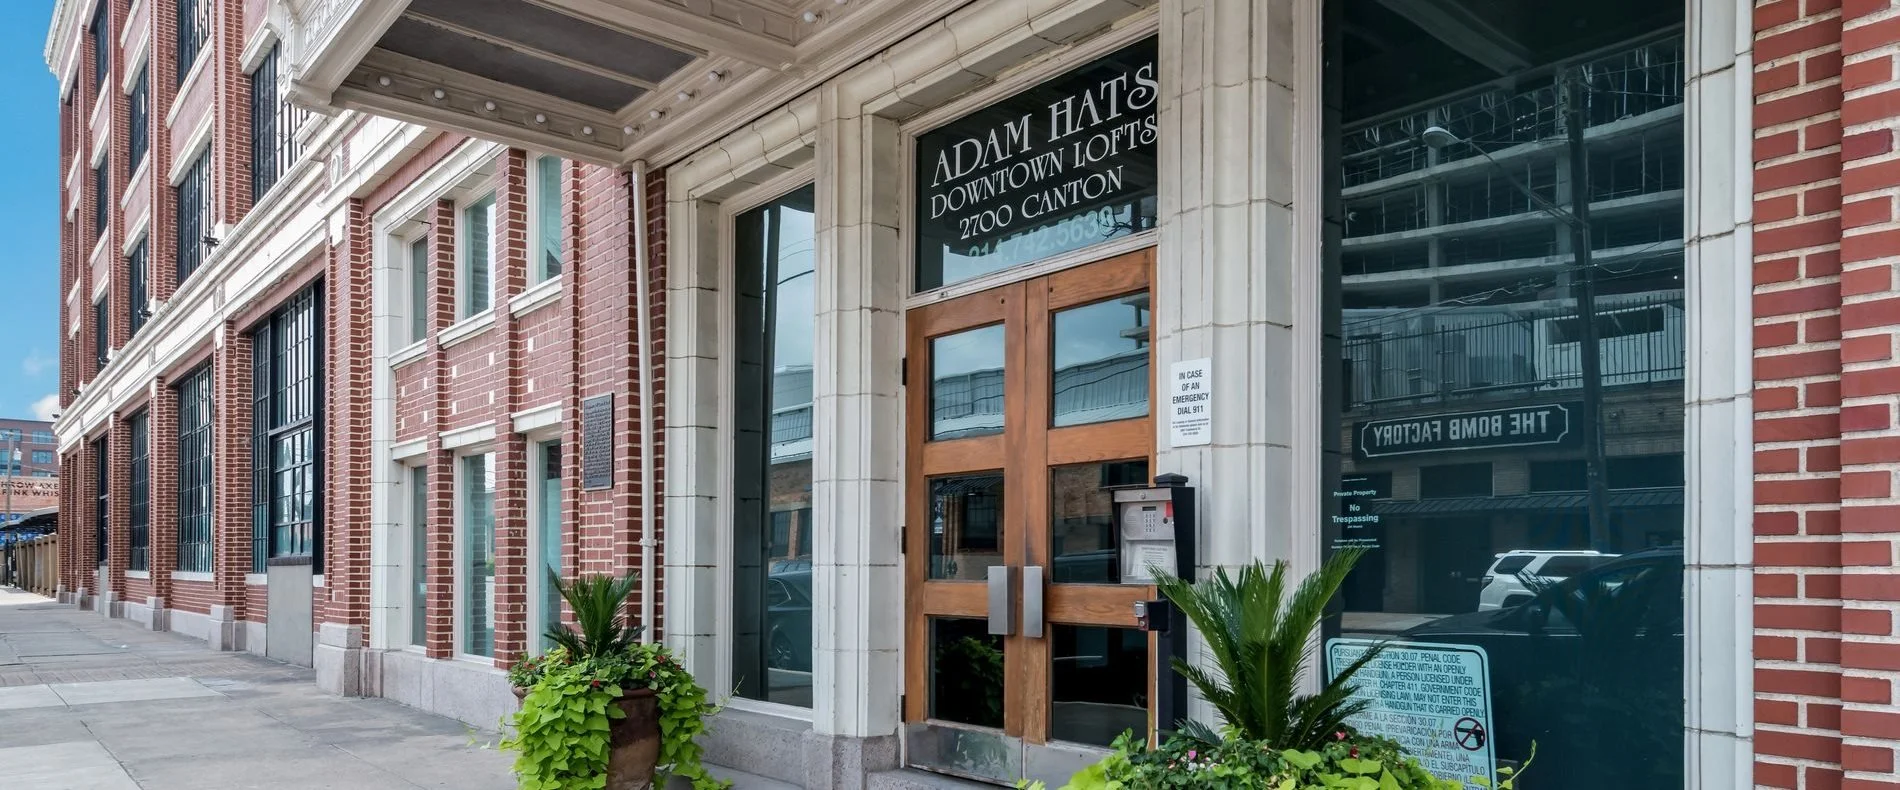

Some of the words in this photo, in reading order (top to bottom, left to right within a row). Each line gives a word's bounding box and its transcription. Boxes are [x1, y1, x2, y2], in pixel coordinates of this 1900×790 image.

[930, 114, 1033, 187] ADAM
[1048, 62, 1158, 142] HATS
[930, 148, 1064, 220] DOWNTOWN
[1073, 114, 1158, 169] LOFTS
[960, 204, 1012, 240] 2700
[1021, 165, 1124, 218] CANTON
[1186, 370, 1203, 379] CASE
[1182, 383, 1190, 391] OF
[1172, 392, 1209, 404] EMERGENCY
[1178, 407, 1191, 415] DIAL
[1193, 406, 1203, 414] 911
[1332, 514, 1379, 524] Trespassing
[1421, 653, 1441, 662] PENAL
[1442, 654, 1461, 664] CODE
[1417, 663, 1432, 672] WITH
[1434, 664, 1442, 672] AN
[1443, 664, 1466, 674] OPENLY
[1396, 672, 1420, 681] PERSON
[1422, 674, 1450, 684] LICENSED
[1451, 675, 1473, 685] UNDER
[1380, 680, 1406, 690] CHAPTER
[1421, 684, 1462, 695] GOVERNMENT
[1464, 687, 1482, 697] CODE
[1414, 693, 1426, 702] MAY
[1428, 694, 1440, 703] NOT
[1442, 695, 1461, 705] ENTER
[1463, 697, 1477, 706] THIS
[1413, 703, 1427, 712] THAT
[1429, 704, 1434, 713] IS
[1435, 705, 1460, 716] CARRIED
[1462, 707, 1484, 718] OPENLY
